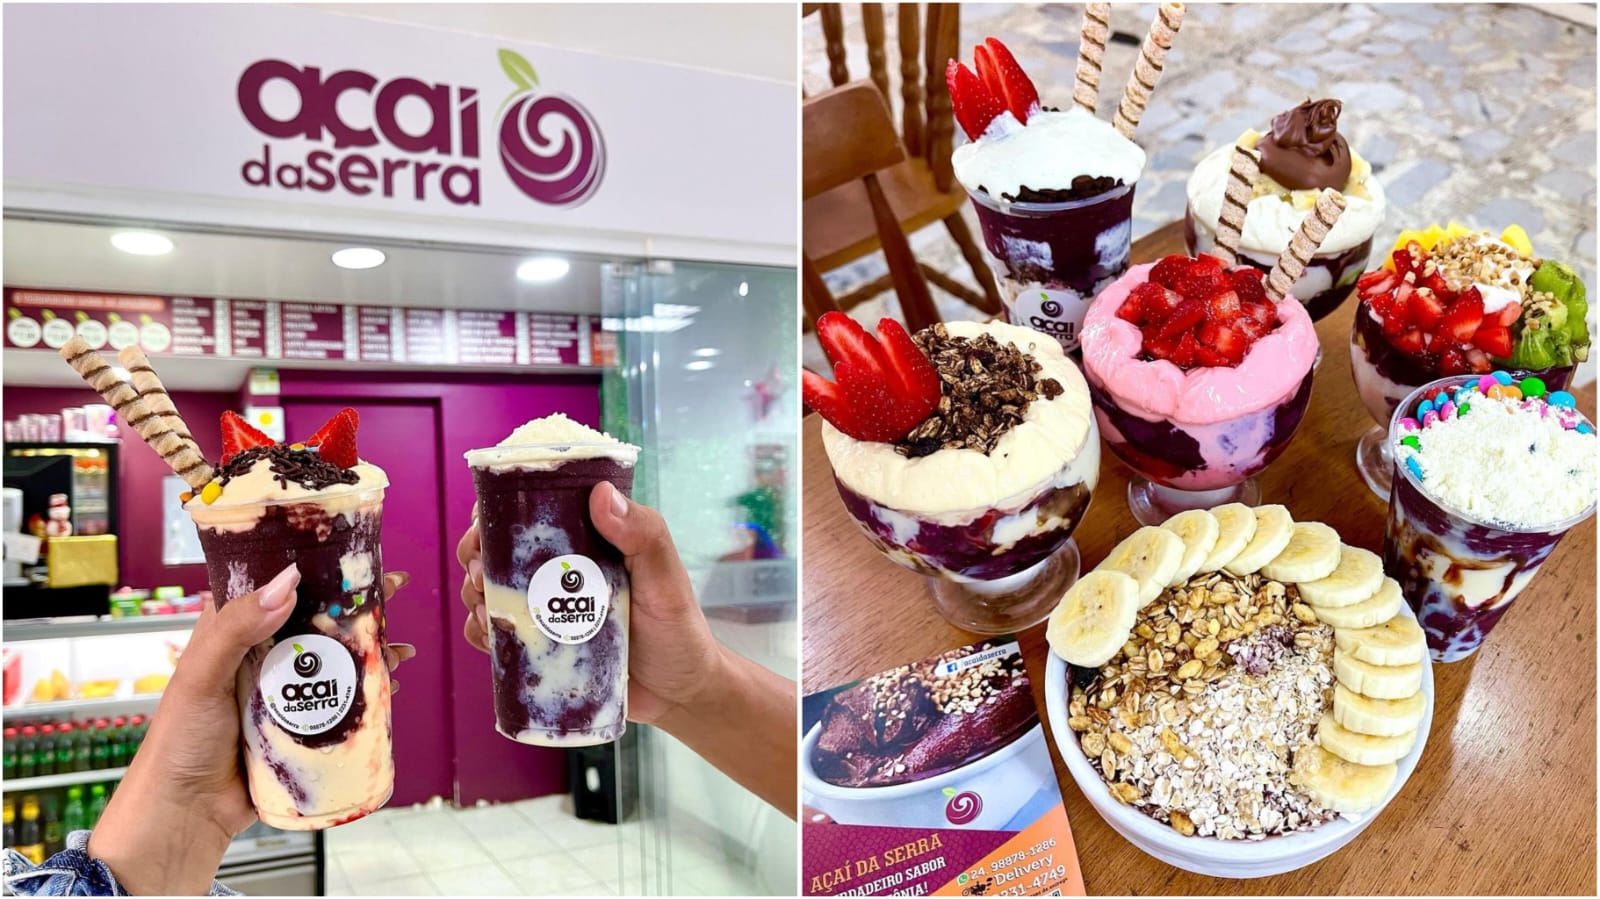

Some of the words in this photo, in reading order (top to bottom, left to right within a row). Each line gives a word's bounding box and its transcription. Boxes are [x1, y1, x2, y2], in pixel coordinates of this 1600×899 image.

[810, 860, 853, 894] AÇAÍ
[855, 855, 881, 877] DA
[883, 833, 943, 868] SERRA
[991, 838, 1056, 872] 98878-1286
[994, 854, 1053, 886] Delivery
[834, 871, 904, 897] DADEIRO
[905, 855, 947, 881] SABOR
[885, 881, 929, 897] ÔNIA!
[993, 864, 1066, 897] 231-4749
